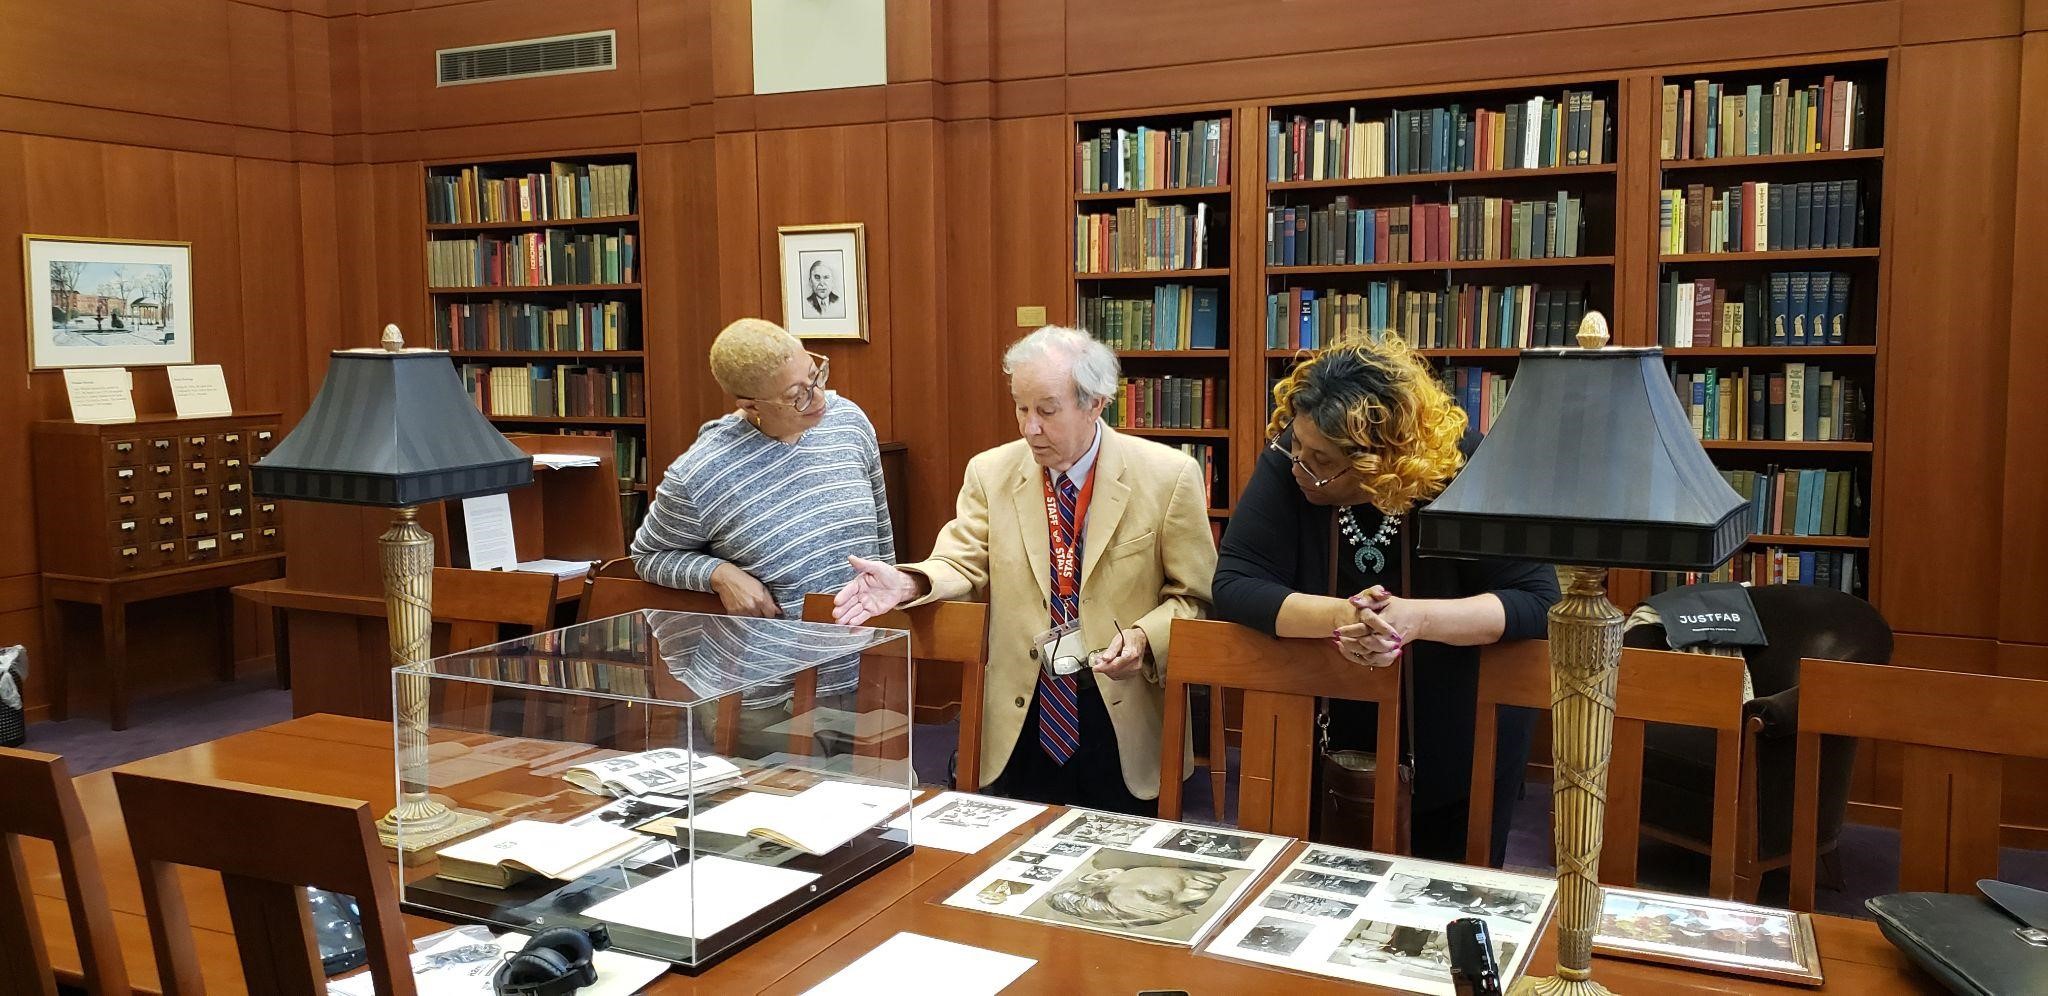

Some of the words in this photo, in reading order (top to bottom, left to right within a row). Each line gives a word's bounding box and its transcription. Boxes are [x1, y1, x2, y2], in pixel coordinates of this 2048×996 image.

[1046, 496, 1059, 526] STAFF
[1055, 547, 1065, 576] STA
[1679, 613, 1741, 624] JUSTFAB
